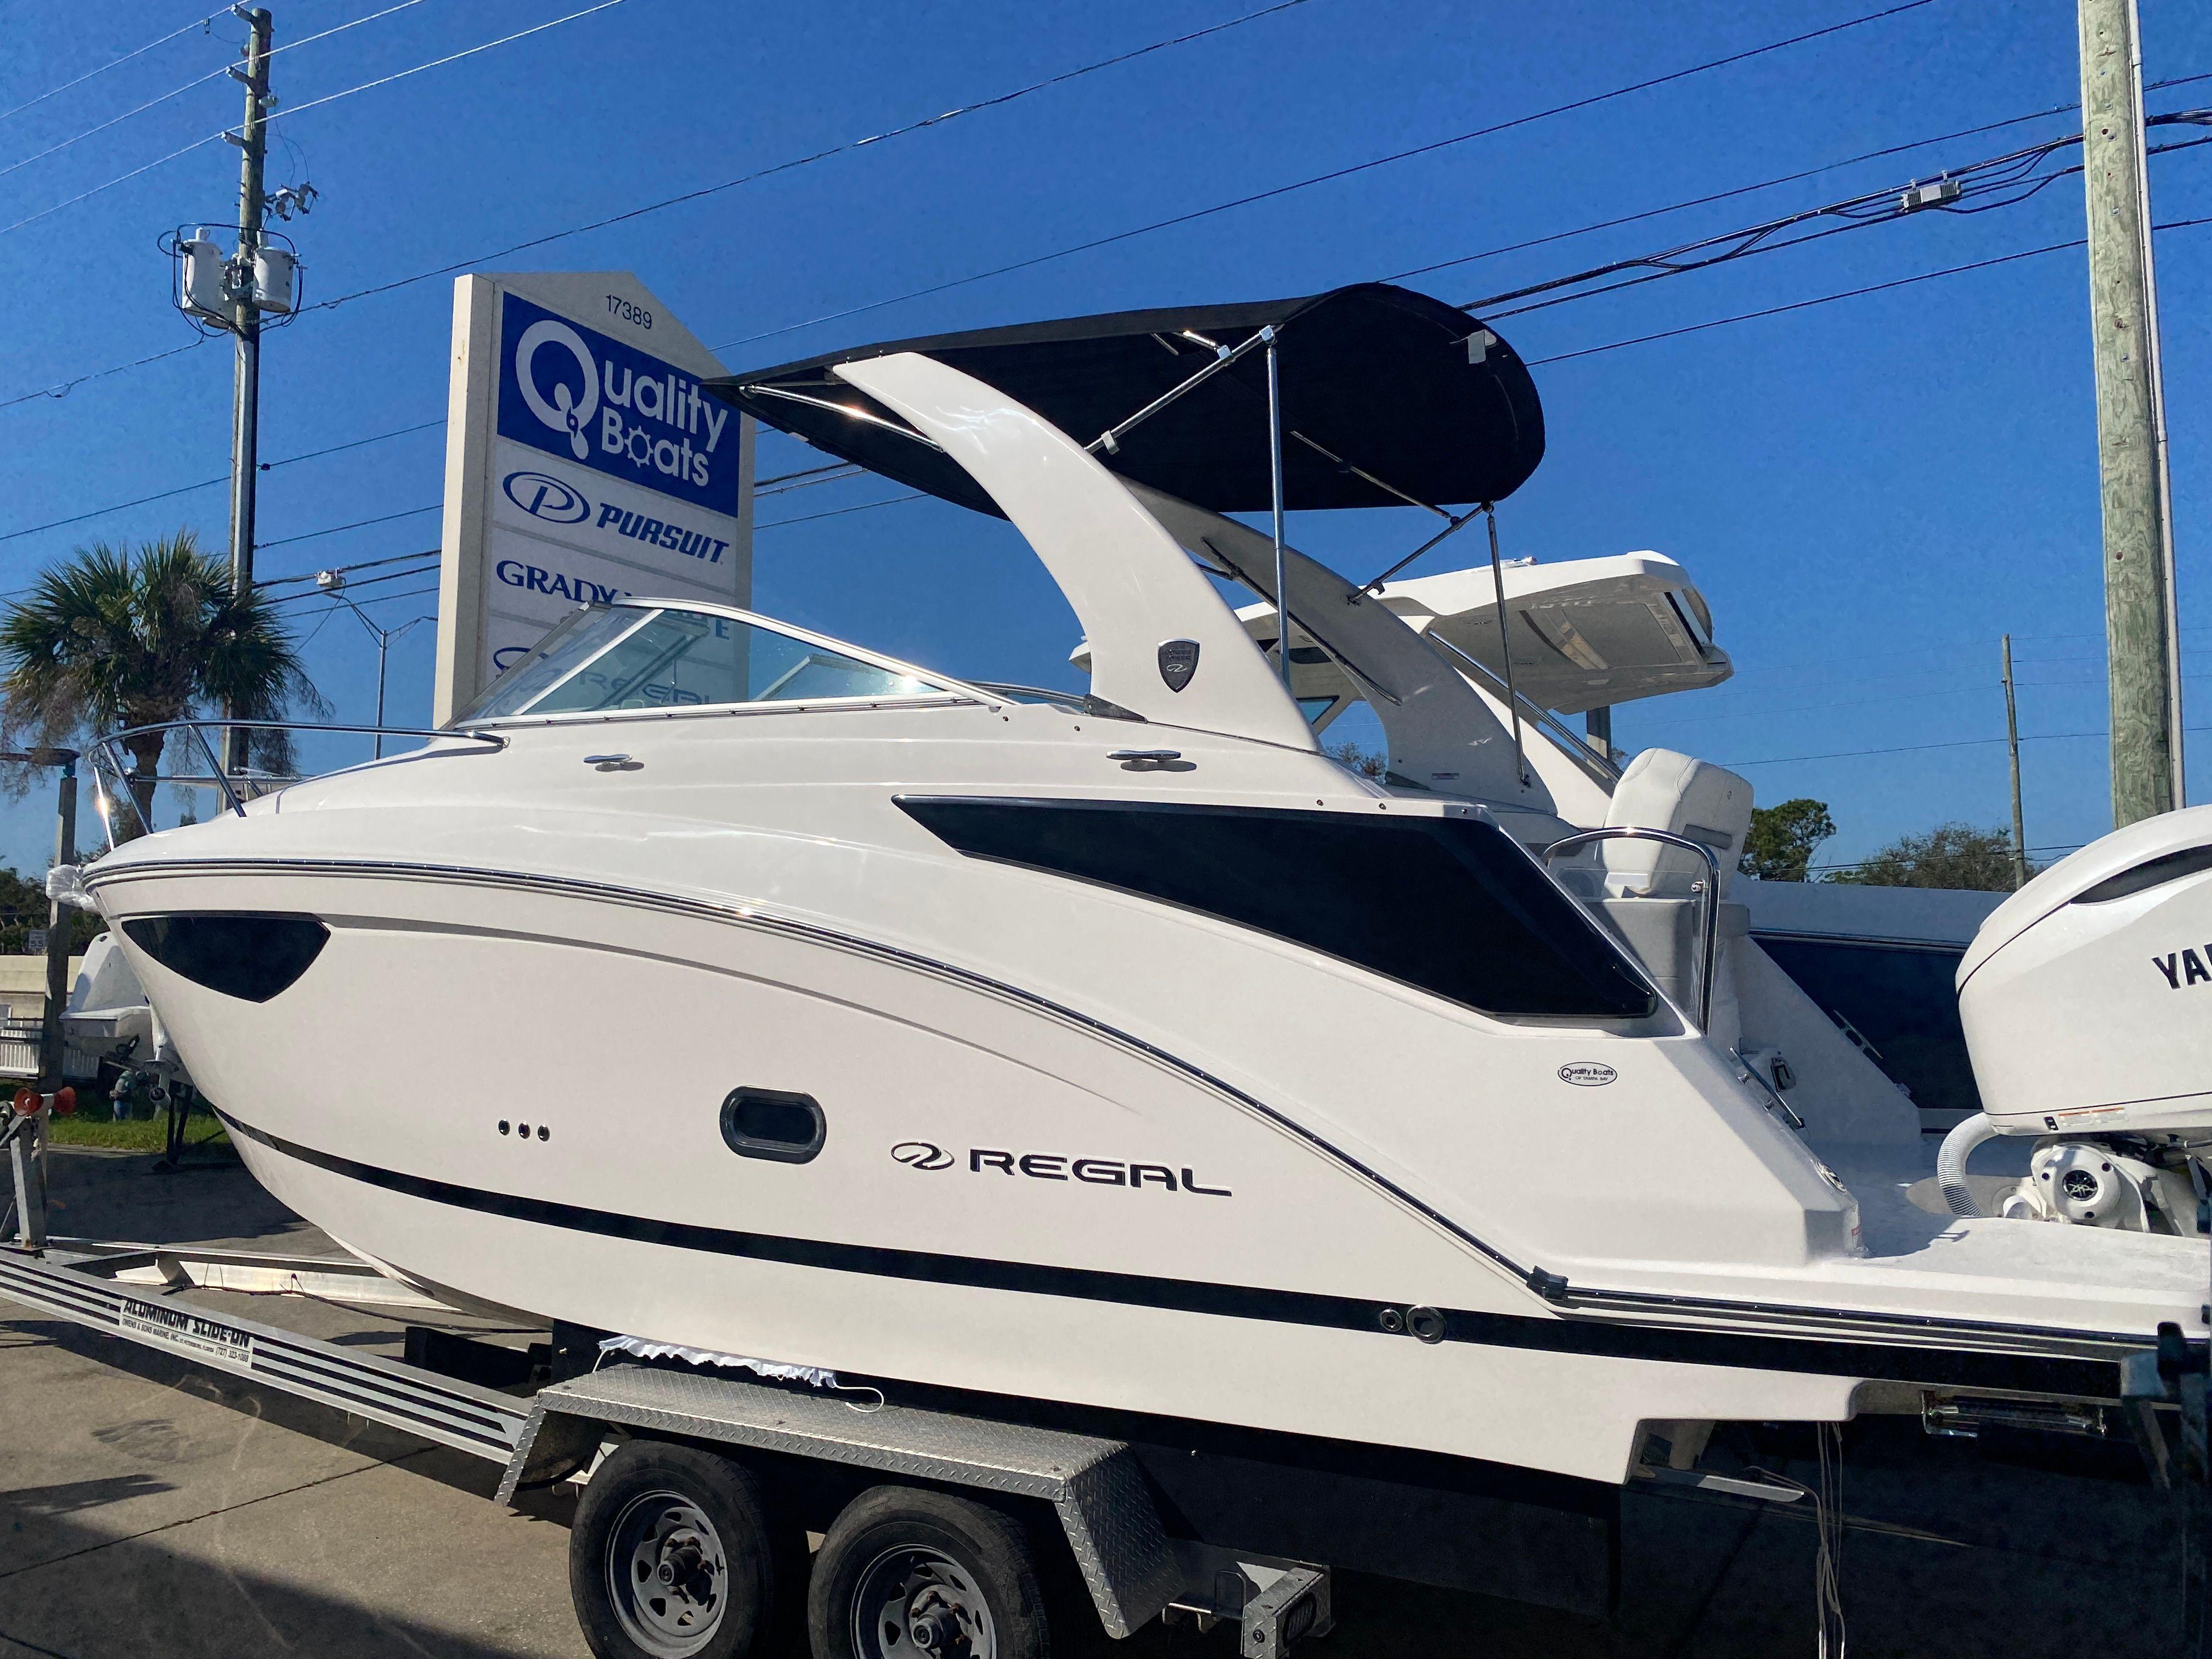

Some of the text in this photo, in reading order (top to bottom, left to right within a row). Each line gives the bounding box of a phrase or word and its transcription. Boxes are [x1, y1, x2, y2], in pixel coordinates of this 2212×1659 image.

[606, 294, 652, 329] 17389
[516, 320, 728, 460] Quality
[601, 406, 709, 487] Boats
[596, 503, 729, 564] PURSUIT
[496, 560, 618, 602] GRADY
[2152, 943, 2212, 990] YA
[1561, 1068, 1592, 1081] Quality
[969, 1148, 1233, 1197] REGAL
[124, 1300, 189, 1332] ALUMINUM
[140, 1324, 153, 1334] SONS
[215, 1346, 228, 1358] (727)
